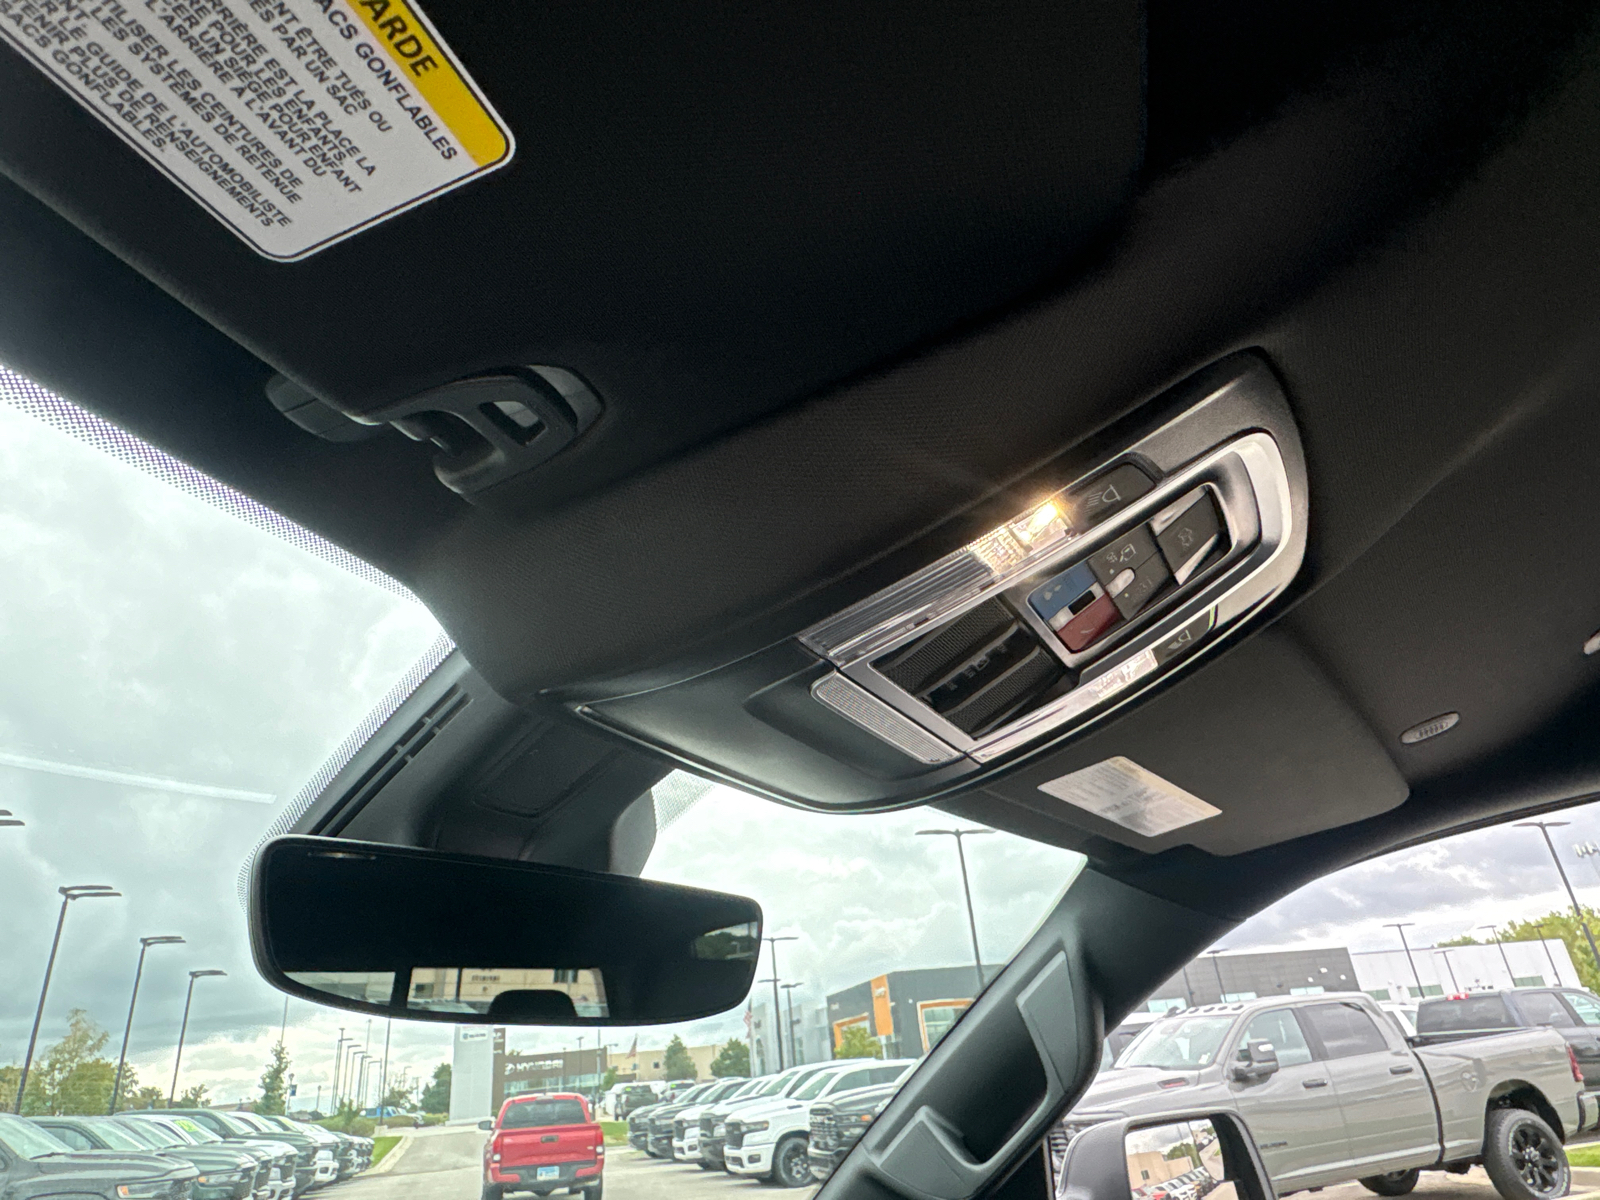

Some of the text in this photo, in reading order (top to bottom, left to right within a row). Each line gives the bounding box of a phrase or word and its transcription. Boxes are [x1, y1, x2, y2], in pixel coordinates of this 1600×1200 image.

[52, 50, 166, 152] GONFLABLES.
[58, 16, 87, 40] LE
[86, 42, 143, 92] GUIDE
[141, 92, 169, 115] DE
[166, 115, 292, 227] L'AUTOMOBILISTE
[90, 6, 302, 204] LES SYSTÈMES DE RETENUE
[166, 59, 202, 90] LES
[201, 92, 282, 168] CEINTURES
[280, 168, 303, 188] DE
[198, 30, 226, 54] UN
[224, 57, 272, 103] SIÈGE
[268, 103, 312, 144] POUR
[308, 144, 362, 192] ENFANT
[208, 20, 257, 68] POUR
[253, 68, 287, 98] LES
[283, 99, 346, 165] ENFANTS.
[264, 58, 298, 87] EST
[293, 89, 315, 111] LA
[313, 111, 361, 157] PLACE
[355, 156, 376, 176] LA
[271, 23, 307, 59] PAR
[305, 59, 330, 83] UN
[326, 84, 358, 115] SAC
[294, 27, 337, 71] ÊTRE
[334, 70, 371, 110] TUÉS
[369, 111, 393, 132] OU
[355, 42, 458, 160] GONFLABLES
[69, 46, 119, 89] PLUS
[118, 89, 146, 113] DE
[143, 112, 274, 226] RENSEIGNEMENTS
[245, 98, 308, 155] L'AVANT
[303, 156, 326, 176] DU
